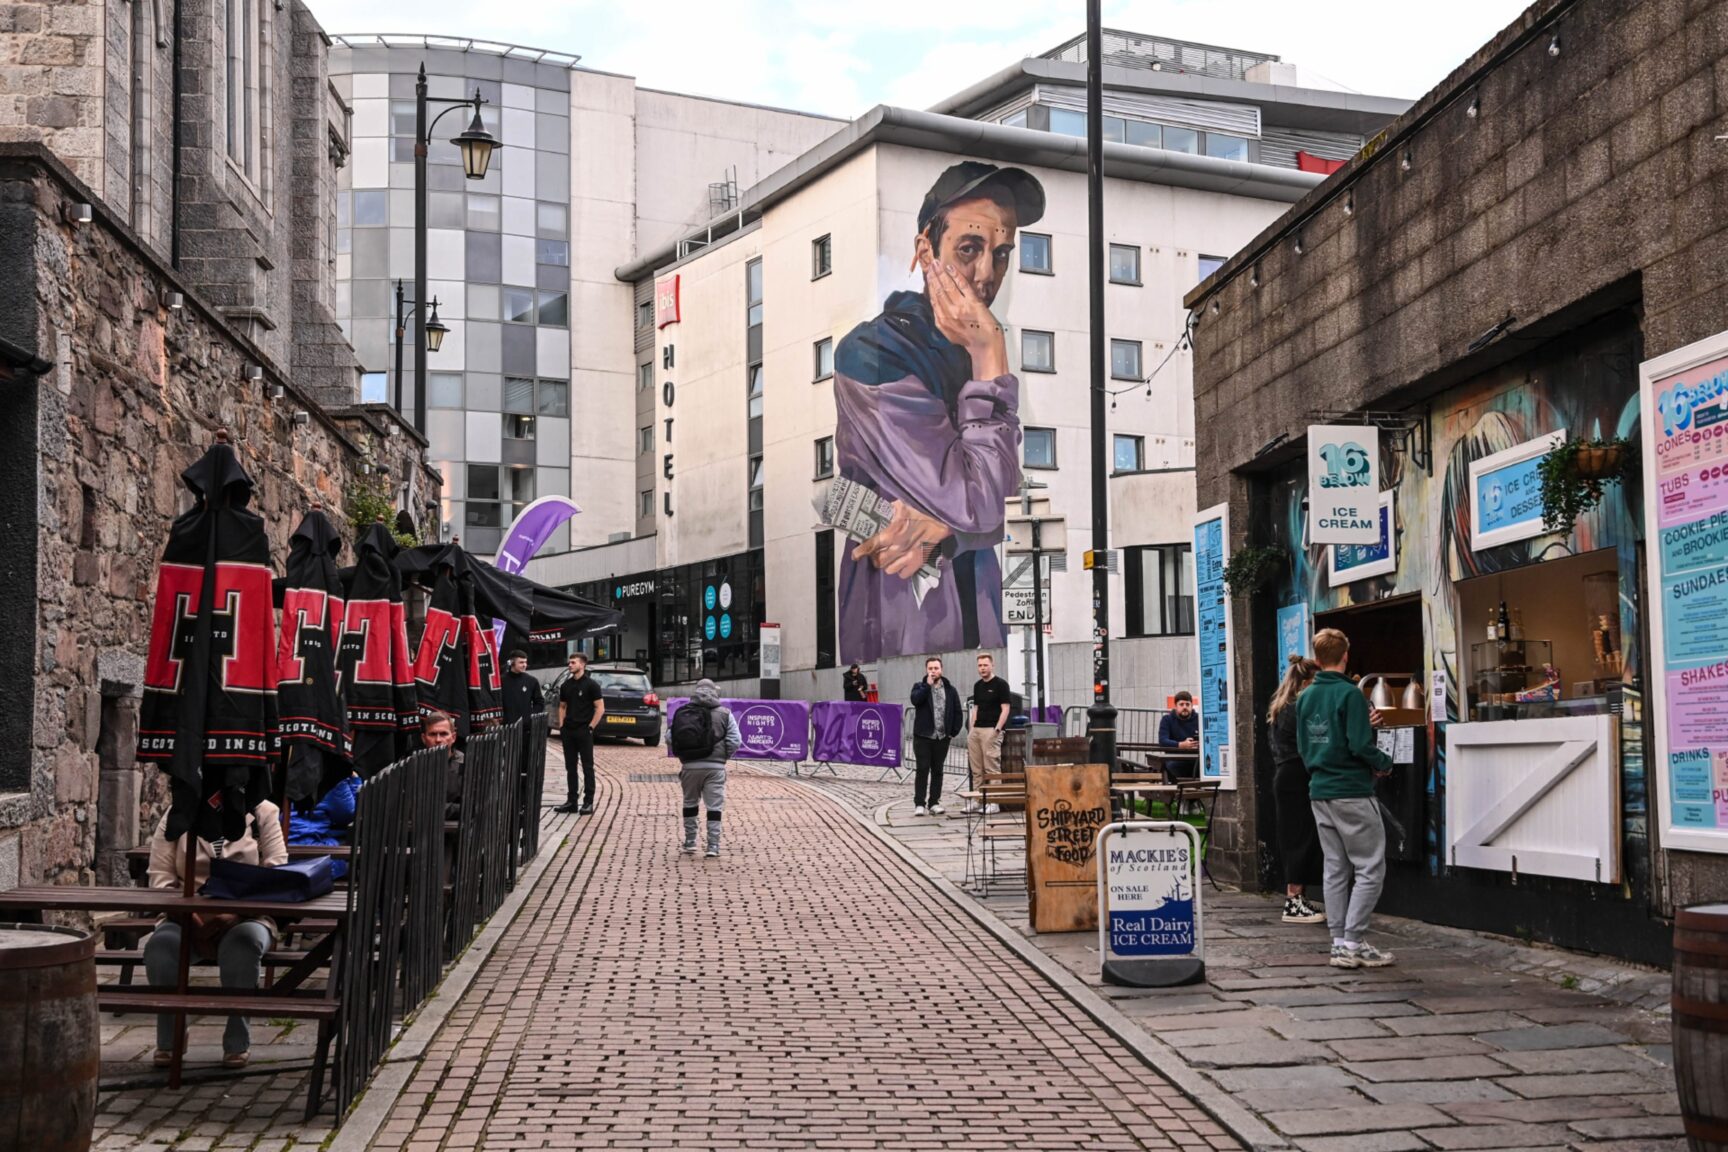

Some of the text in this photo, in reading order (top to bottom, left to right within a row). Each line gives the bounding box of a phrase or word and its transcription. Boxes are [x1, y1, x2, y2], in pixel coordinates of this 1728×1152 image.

[659, 293, 674, 310] ibis
[663, 344, 676, 517] HOTEL
[1657, 430, 1692, 455] CONES
[1319, 442, 1370, 475] 16
[1319, 472, 1371, 488] BELOW
[1504, 478, 1519, 496] ICE
[1660, 473, 1689, 496] TUBS
[1525, 486, 1535, 496] AND
[1333, 507, 1357, 517] ICE
[1510, 494, 1543, 518] DESSE
[1319, 518, 1373, 529] CREAM
[1665, 519, 1706, 545] COOKIE
[622, 581, 654, 598] PUREGYM
[1008, 610, 1045, 620] END
[226, 738, 243, 749] IN
[1672, 747, 1710, 764] DRINKS
[1037, 807, 1106, 830] SHIPYARD
[1047, 827, 1097, 846] STREET
[1055, 846, 1089, 862] FOOD
[1110, 847, 1188, 863] MACKIE'S
[1110, 863, 1187, 874] of Scotland
[1125, 885, 1149, 893] SALE
[1113, 918, 1191, 935] Real Dairy
[1113, 933, 1192, 945] ICE CREAM
